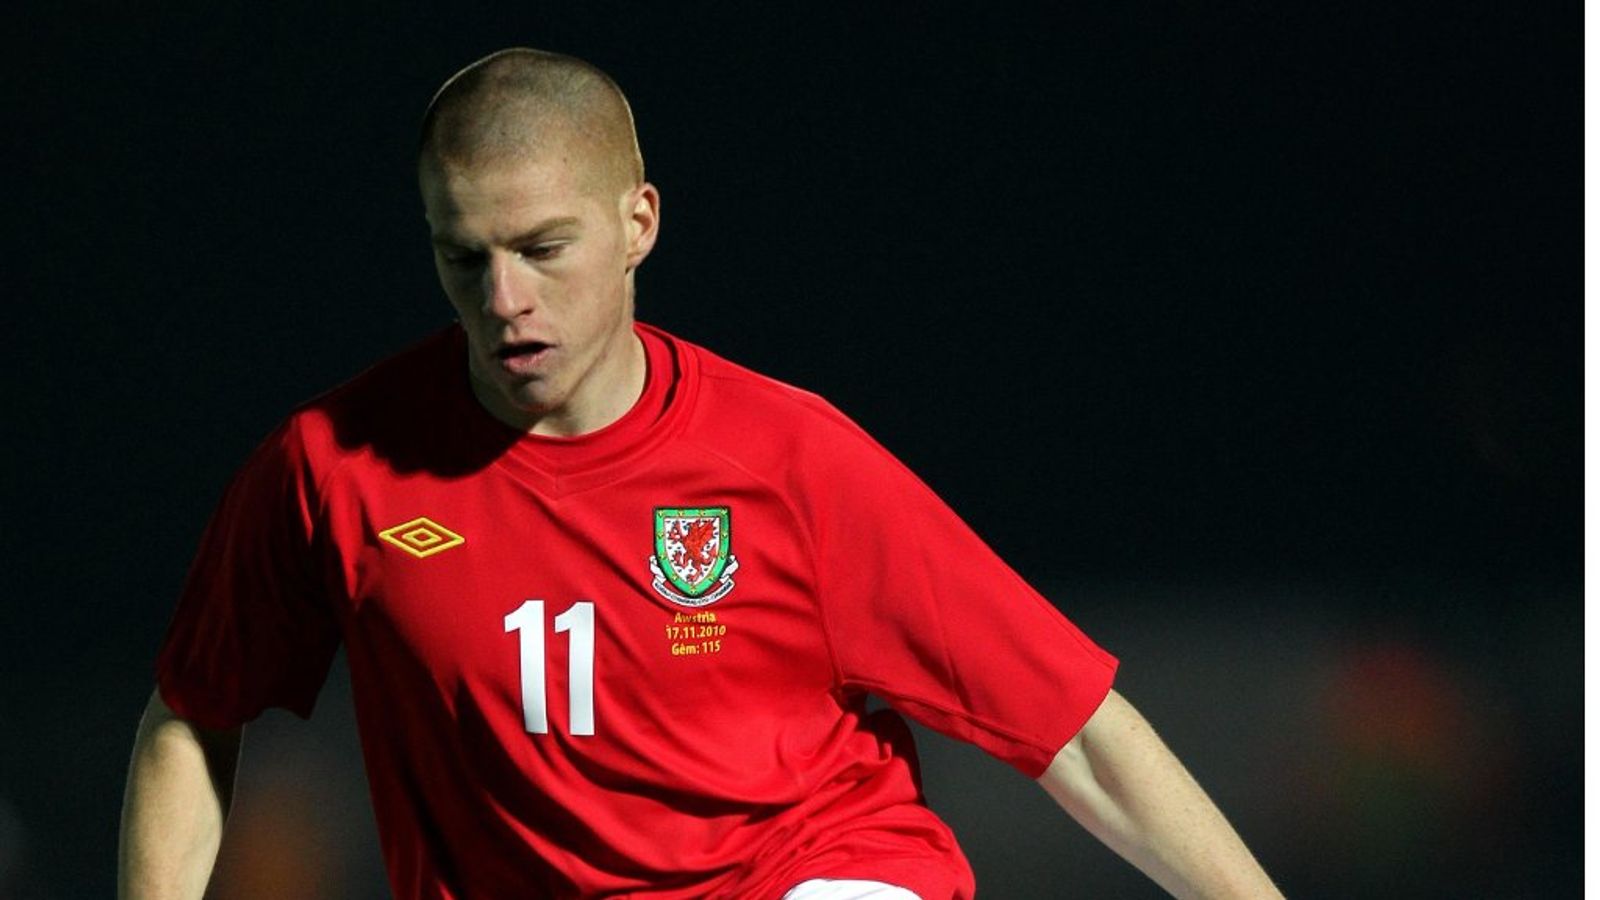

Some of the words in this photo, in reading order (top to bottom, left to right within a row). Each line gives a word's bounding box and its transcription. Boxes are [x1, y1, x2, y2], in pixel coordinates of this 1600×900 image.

[666, 625, 726, 639] 17.11.2010
[702, 640, 721, 653] 115
[504, 600, 595, 735] 11
